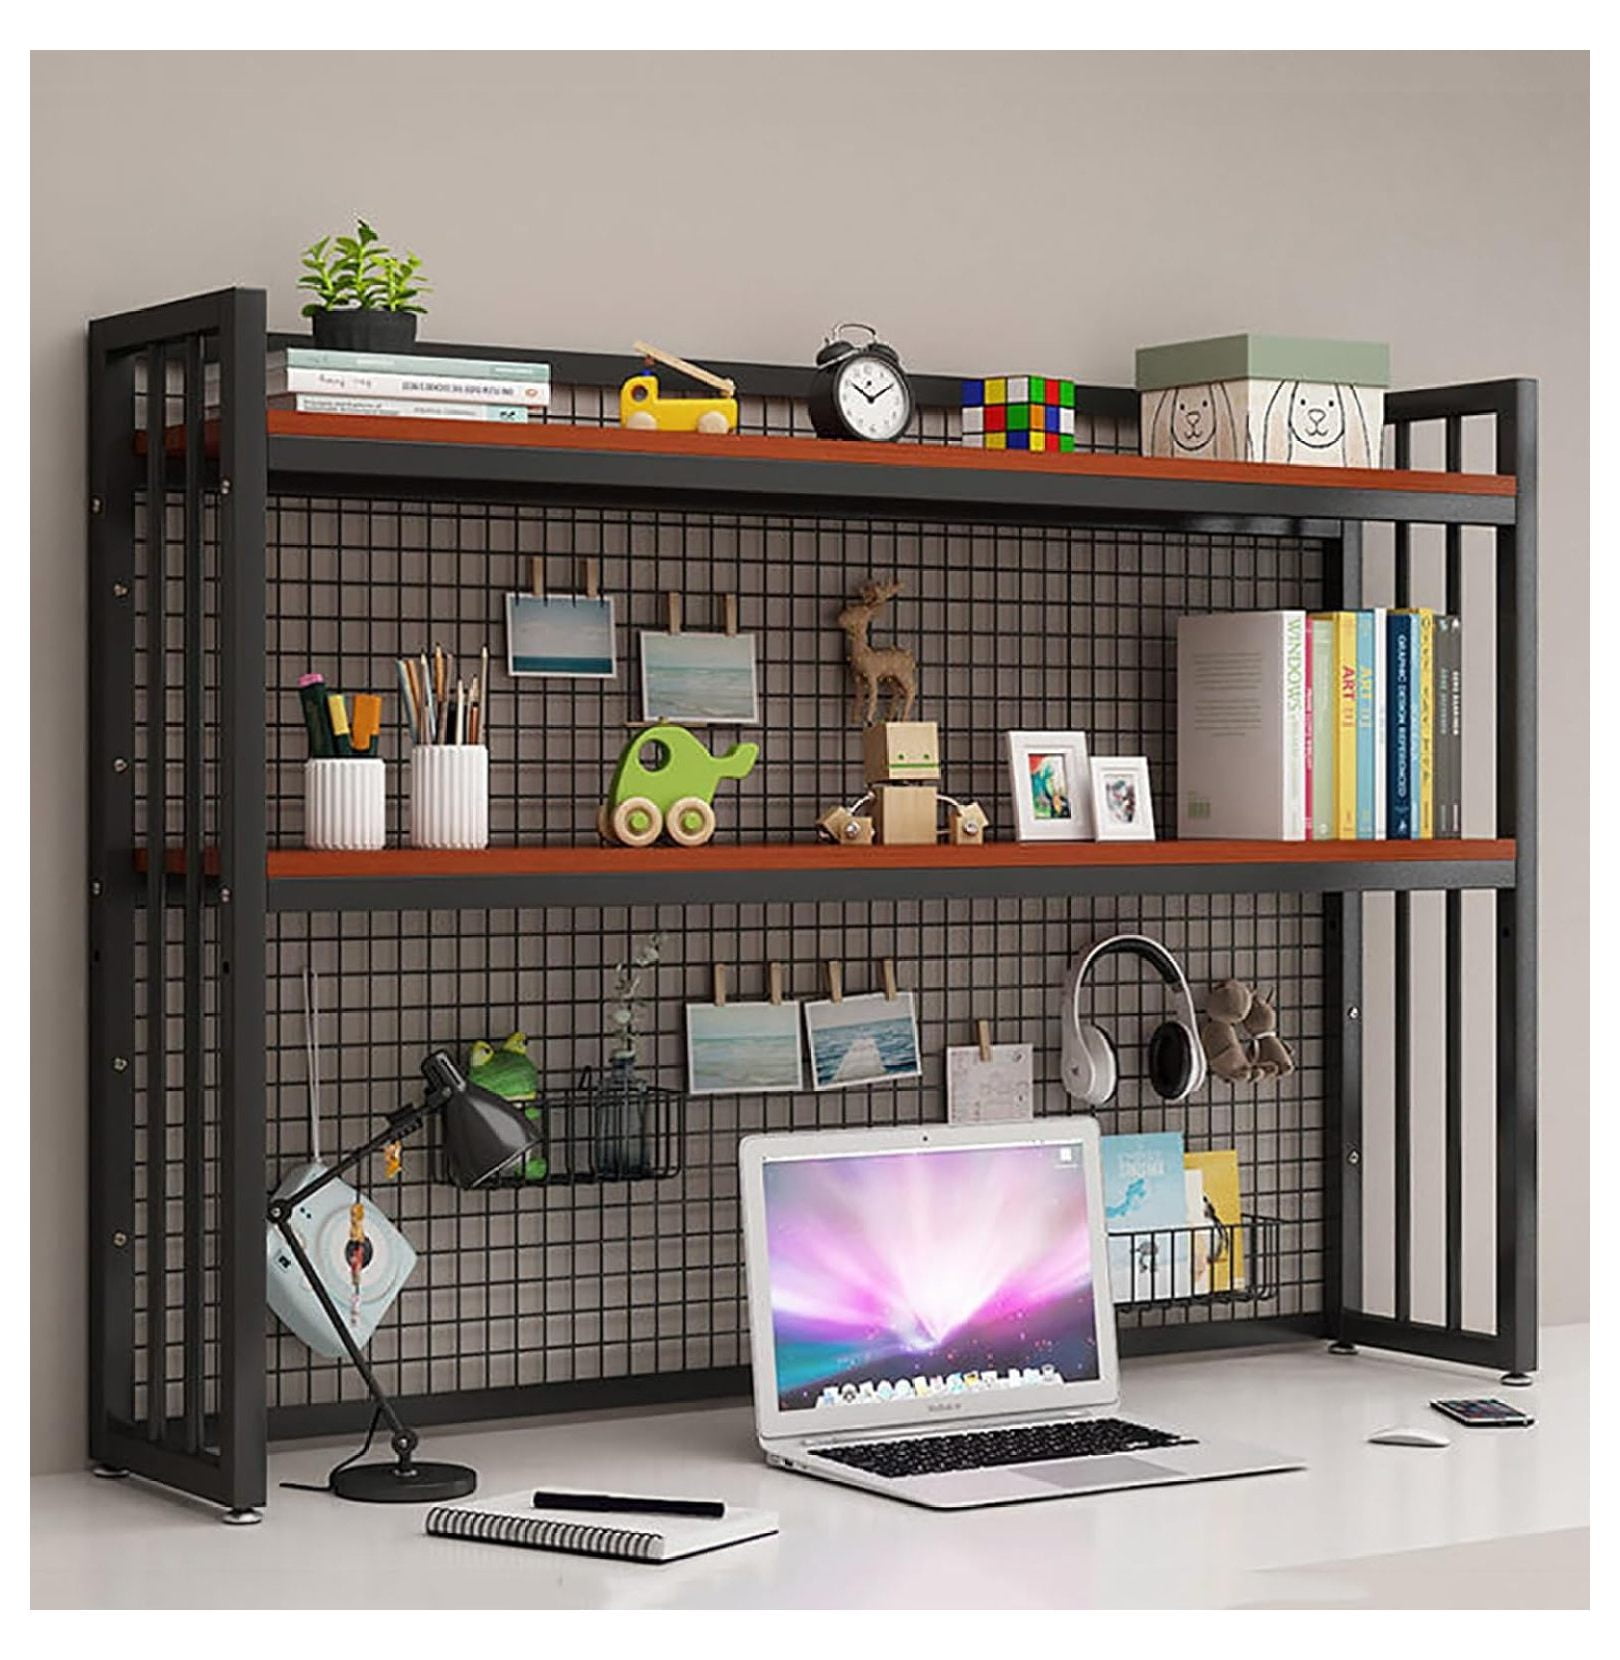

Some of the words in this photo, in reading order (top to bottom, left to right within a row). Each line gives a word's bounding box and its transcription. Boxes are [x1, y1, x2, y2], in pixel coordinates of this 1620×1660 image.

[1287, 618, 1302, 712] WINDOWS
[1397, 634, 1407, 683] GRAPHIC
[1342, 665, 1356, 700] ART
[1359, 666, 1372, 699] ART
[1397, 684, 1407, 724] DESIGN
